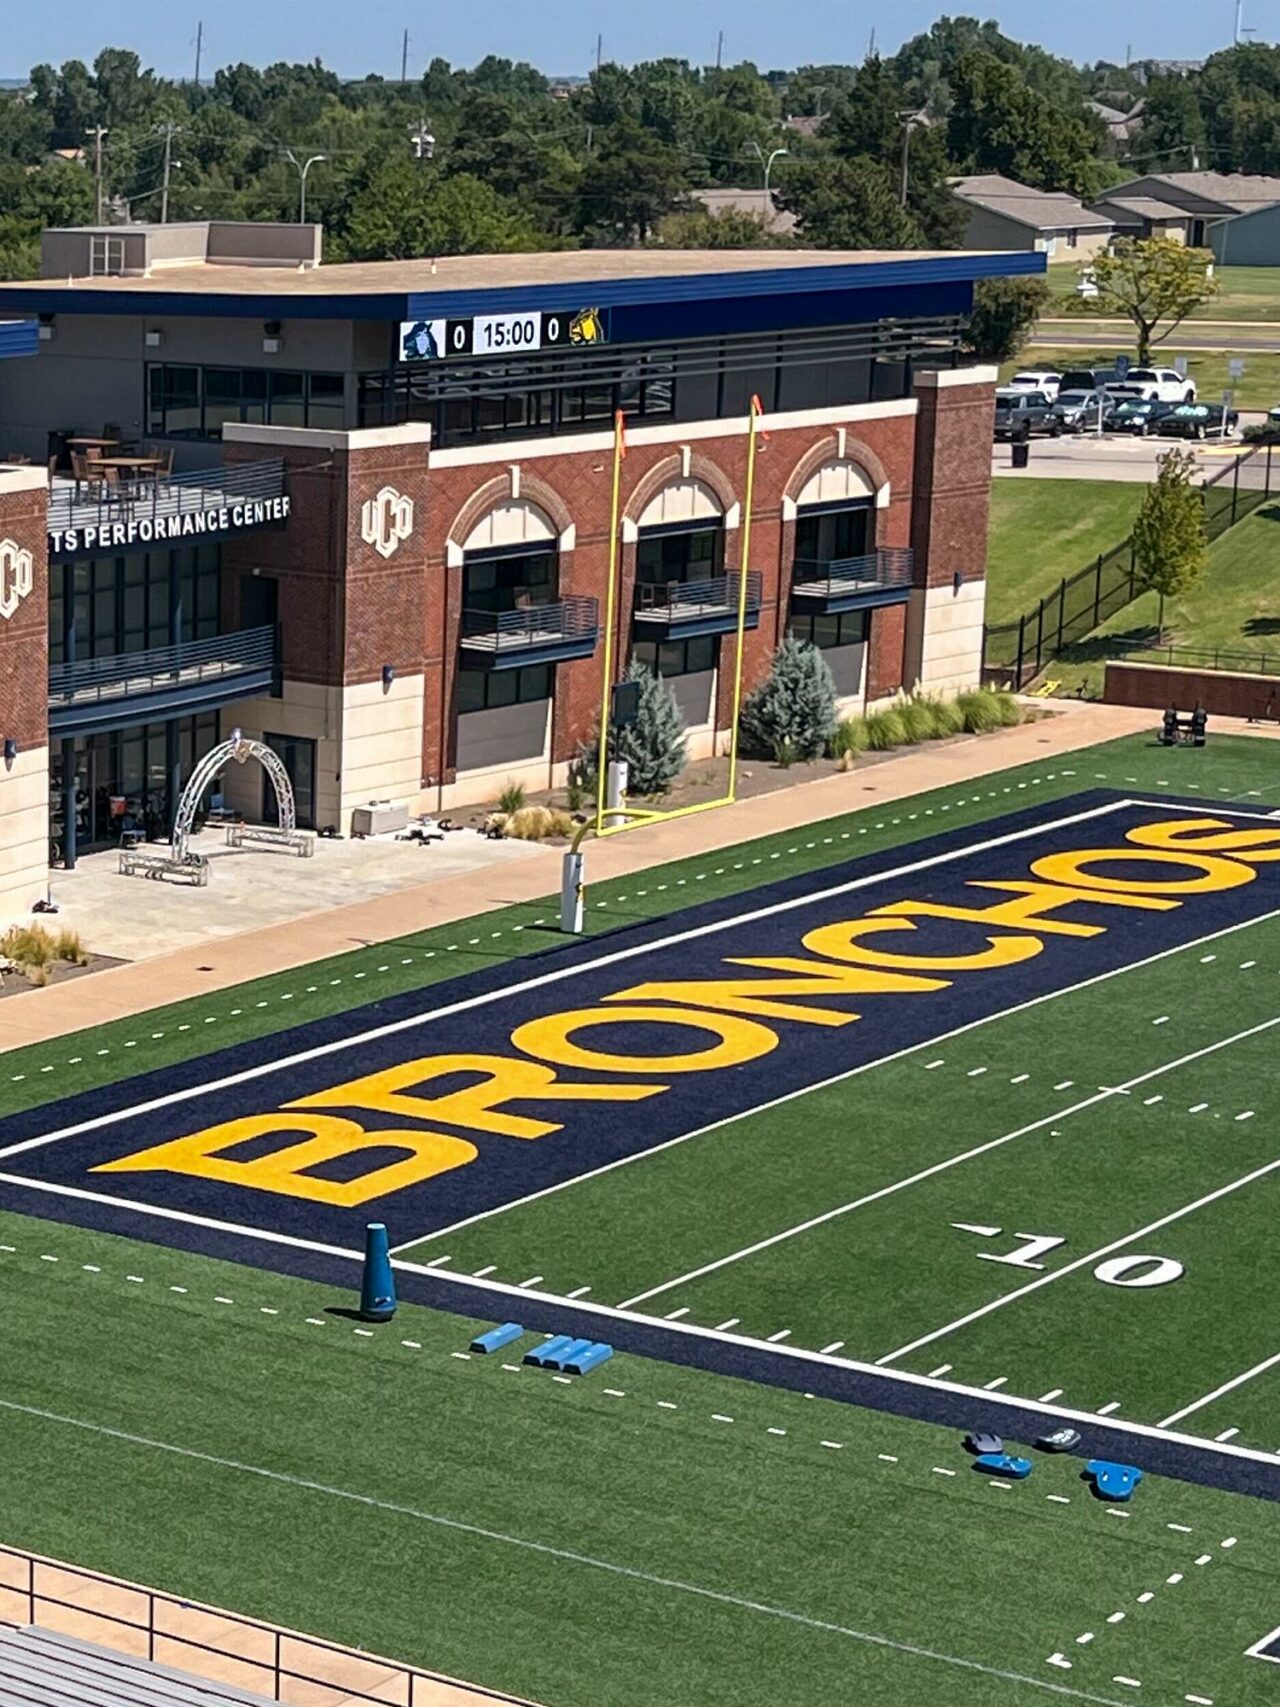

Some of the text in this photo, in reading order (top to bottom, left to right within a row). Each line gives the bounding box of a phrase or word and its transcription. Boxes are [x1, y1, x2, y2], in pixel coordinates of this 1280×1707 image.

[484, 320, 535, 348] 15:00
[84, 508, 229, 549] PERFORMANCE
[233, 496, 292, 527] CENTER
[361, 485, 414, 559] UCO
[89, 818, 1280, 1207] BRONCHOS
